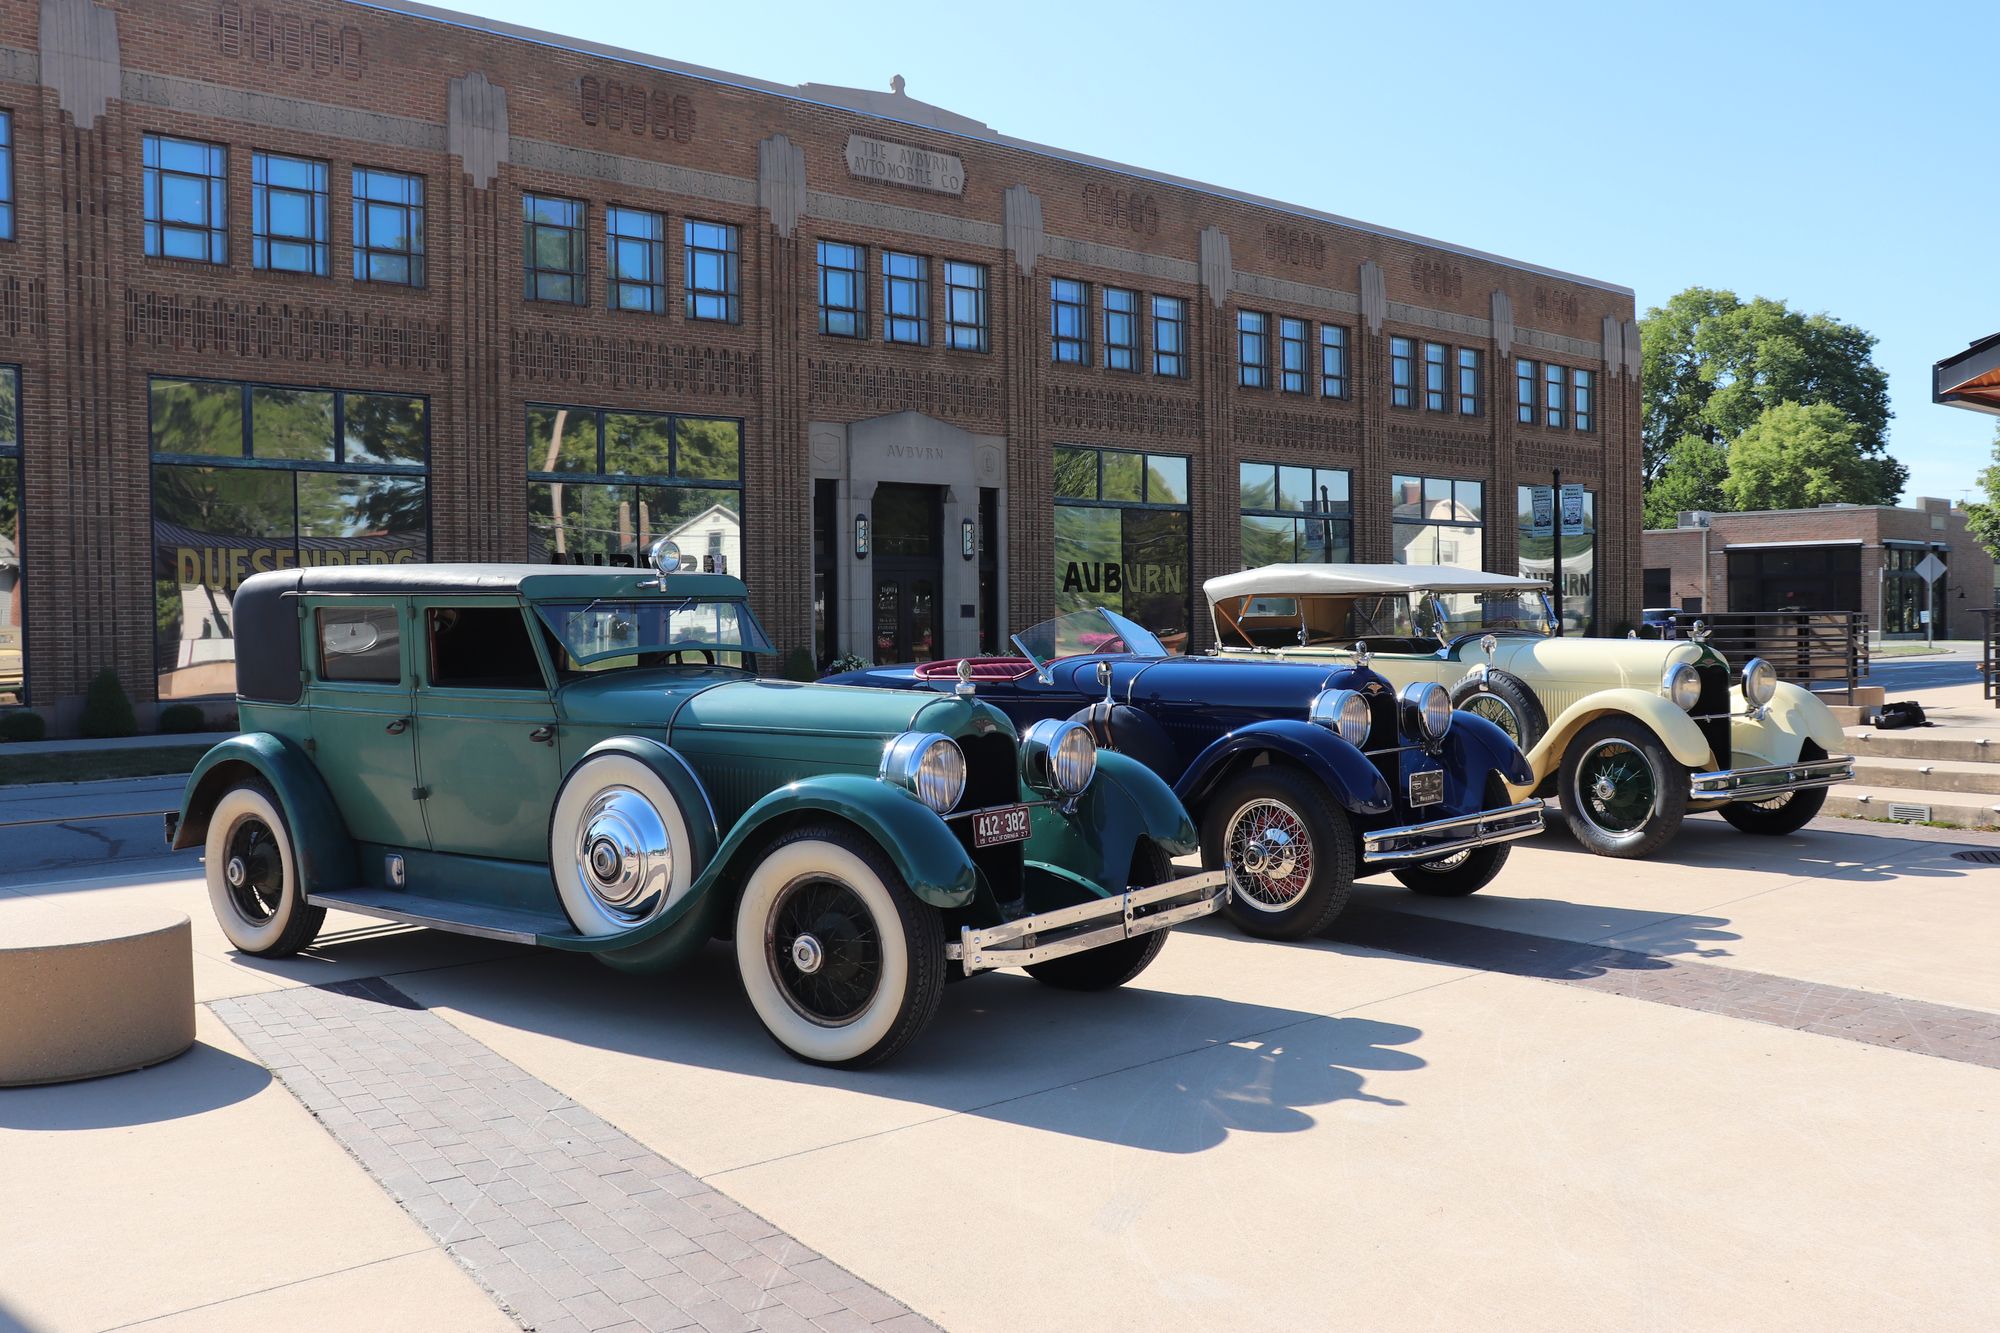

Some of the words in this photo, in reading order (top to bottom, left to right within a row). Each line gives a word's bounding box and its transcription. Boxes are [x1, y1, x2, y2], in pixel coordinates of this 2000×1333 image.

[861, 140, 887, 160] THE
[1063, 562, 1181, 594] AUBURN
[988, 832, 1019, 843] CALIFORNIA
